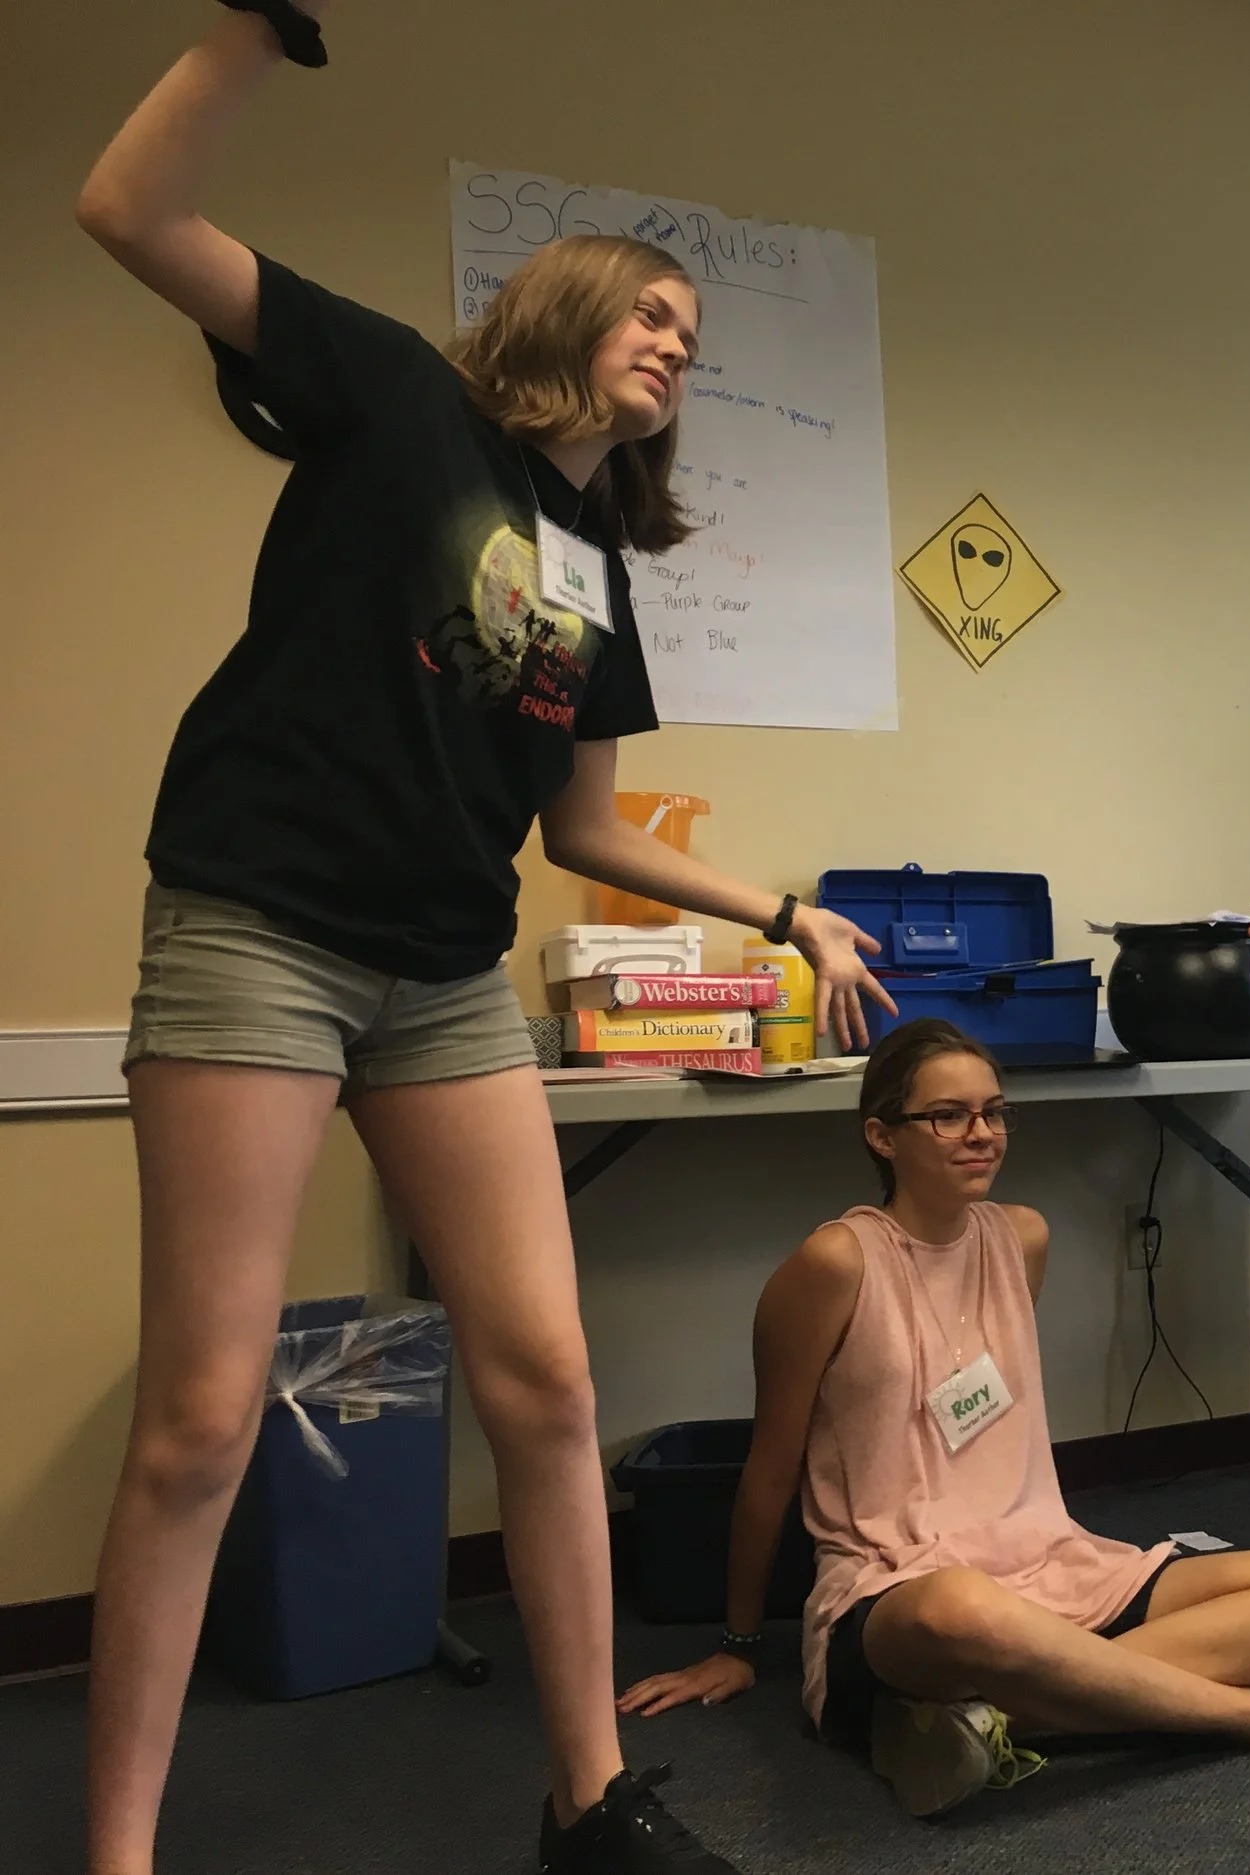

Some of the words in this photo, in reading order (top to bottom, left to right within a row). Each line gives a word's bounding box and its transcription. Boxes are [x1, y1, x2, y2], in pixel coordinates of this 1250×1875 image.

[687, 213, 796, 278] Rules:
[705, 469, 722, 490] you
[733, 478, 748, 489] are
[959, 616, 1003, 643] XING
[653, 632, 685, 654] Not
[707, 629, 739, 652] Blue
[642, 981, 741, 1002] Webster's
[599, 1027, 641, 1037] Children's
[642, 1020, 727, 1040] Dictionary
[659, 1053, 752, 1071] THESAURUS
[951, 1384, 990, 1420] Rory
